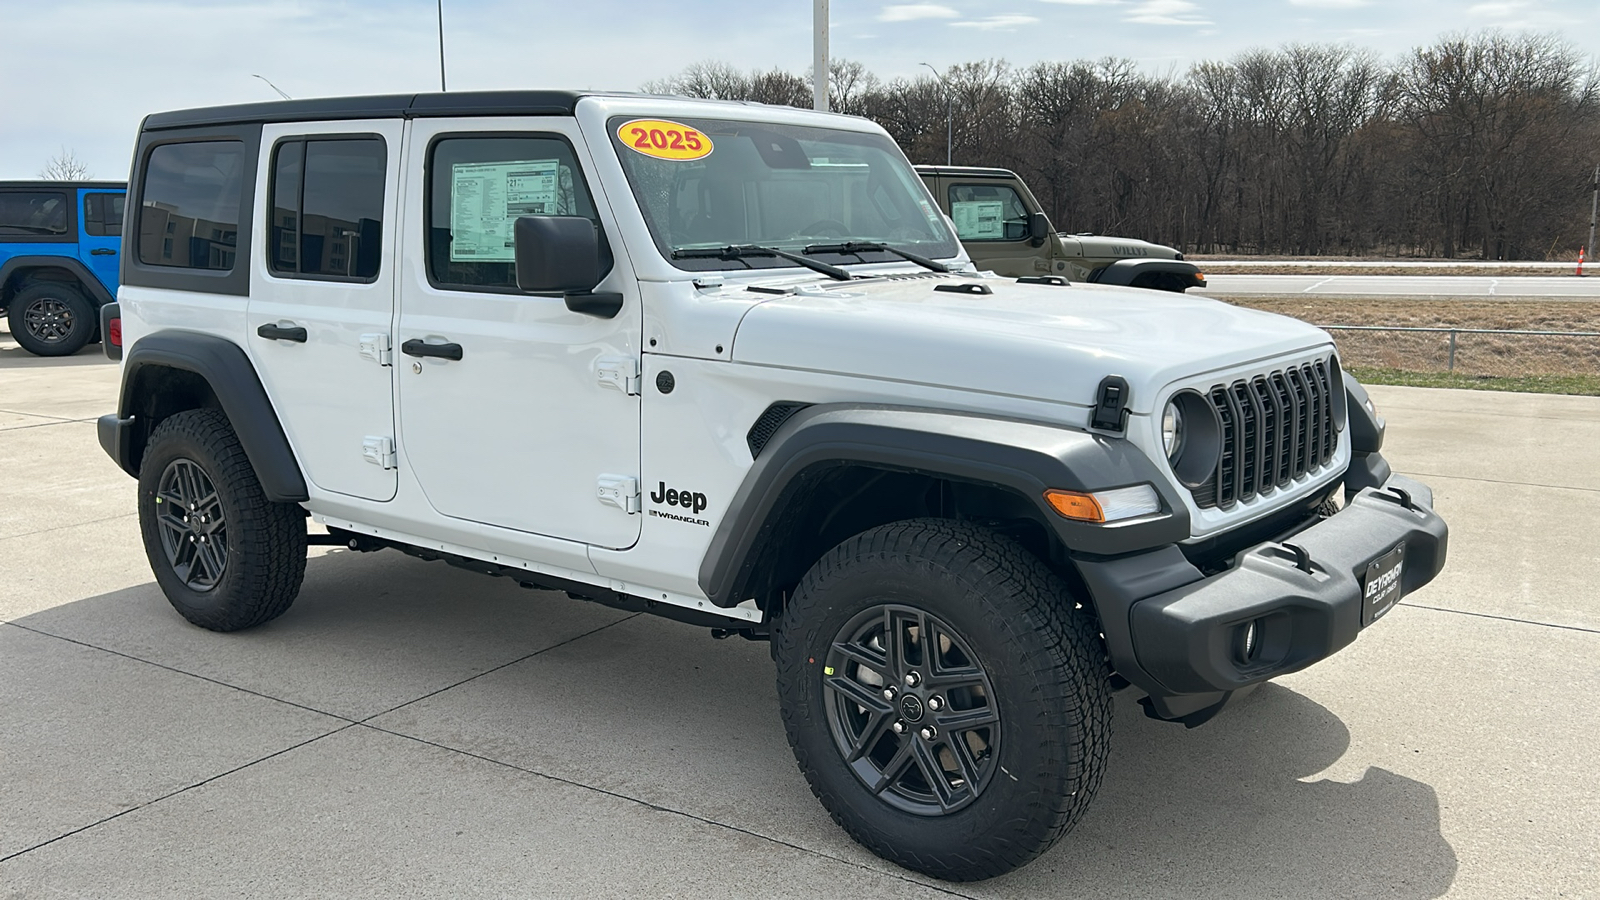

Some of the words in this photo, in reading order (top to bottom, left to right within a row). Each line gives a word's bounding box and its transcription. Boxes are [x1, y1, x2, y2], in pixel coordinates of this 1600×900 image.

[631, 127, 702, 151] 2025
[1110, 245, 1148, 256] WILLYS
[650, 481, 708, 515] Jeep
[657, 511, 710, 527] WRANGLER
